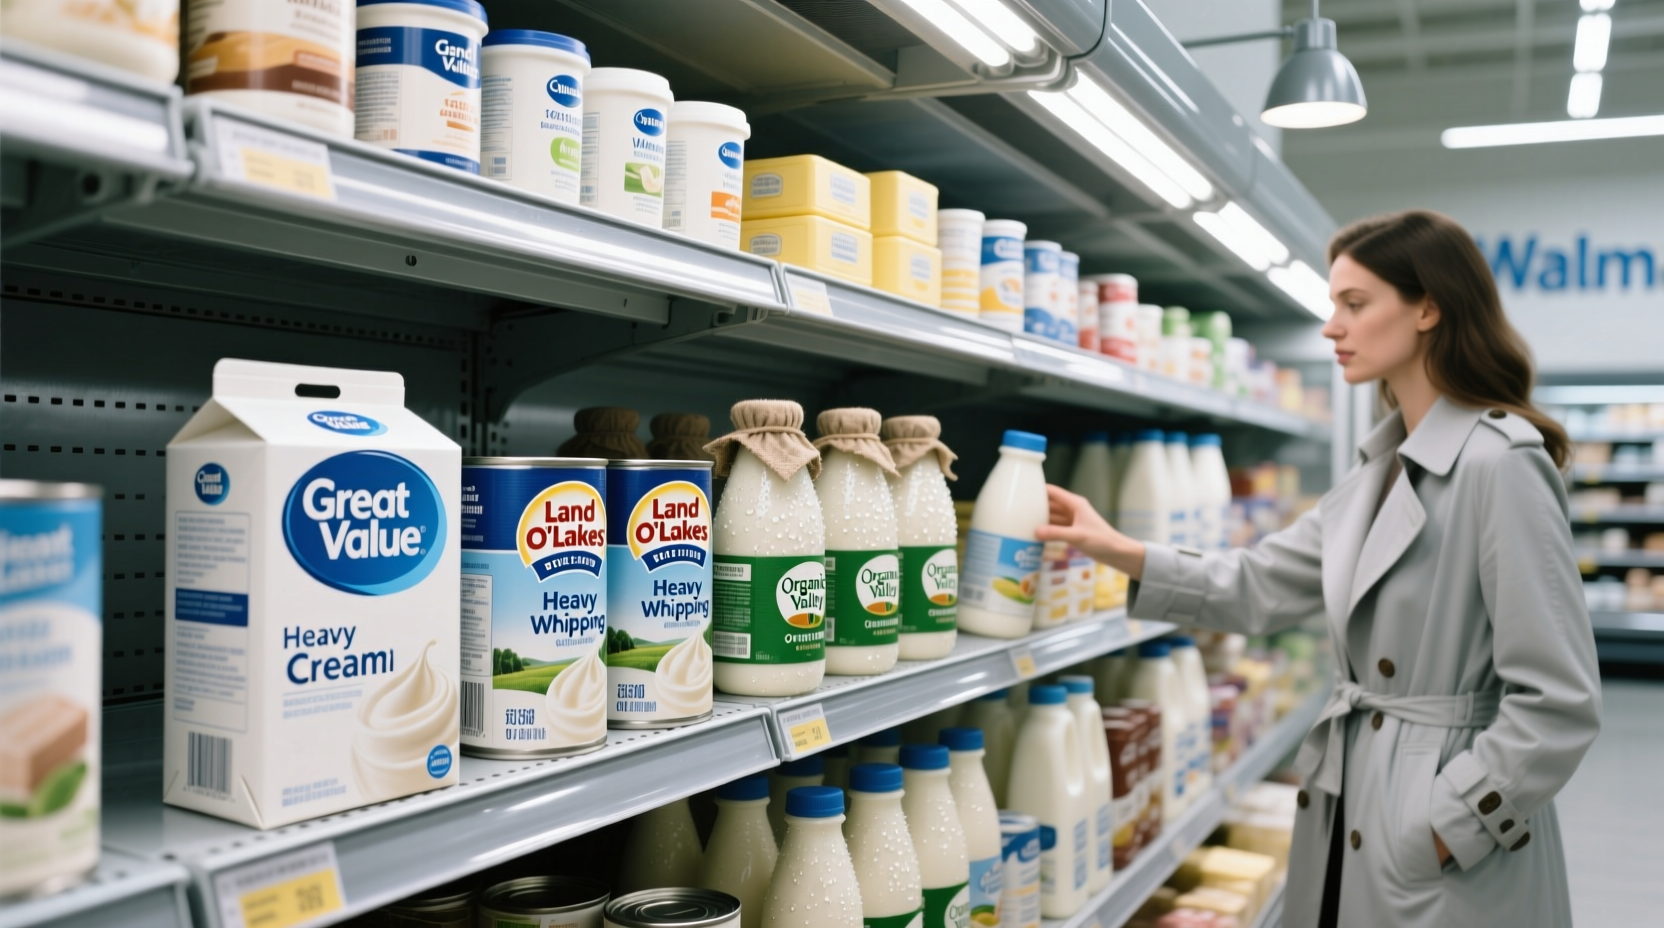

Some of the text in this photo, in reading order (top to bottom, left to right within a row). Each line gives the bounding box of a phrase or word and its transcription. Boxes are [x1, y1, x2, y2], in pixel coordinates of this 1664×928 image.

[302, 477, 410, 521] Great
[545, 499, 595, 523] Land
[652, 497, 699, 520] Land
[319, 518, 421, 560] Value
[526, 524, 605, 550] O'Lakes
[635, 520, 708, 544] O'Lakes
[653, 579, 702, 600] Heavy
[543, 591, 597, 614] Heavy
[641, 599, 709, 622] Whipping
[530, 613, 605, 637] Whipping
[284, 626, 356, 650] Heavy
